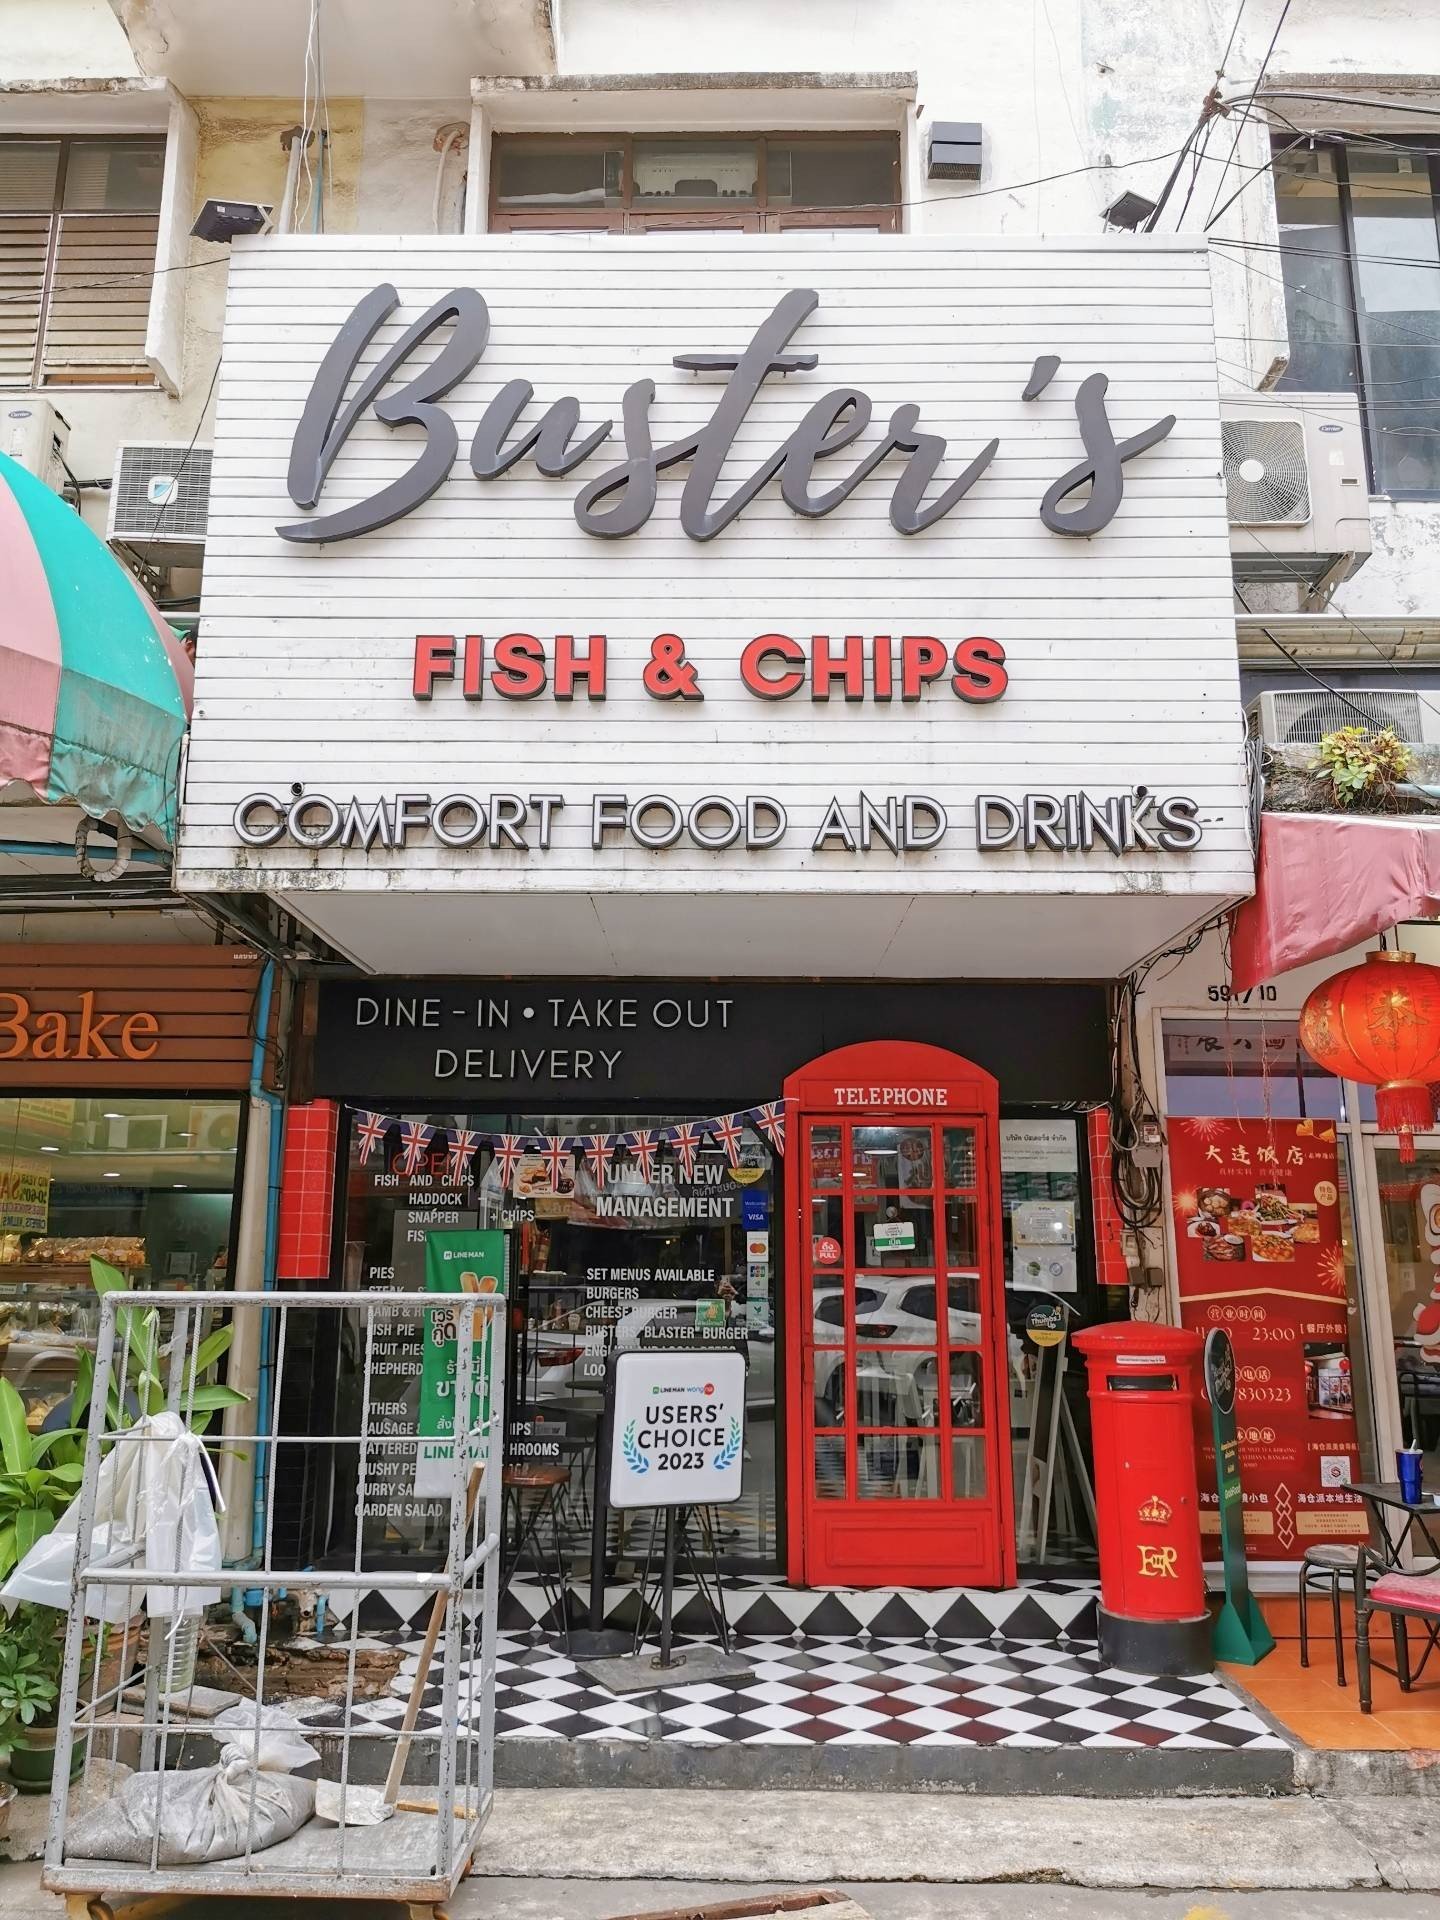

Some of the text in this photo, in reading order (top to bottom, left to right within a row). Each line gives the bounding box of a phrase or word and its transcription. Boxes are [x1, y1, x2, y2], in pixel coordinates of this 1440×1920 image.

[276, 283, 1176, 545] Buster's
[412, 634, 1010, 703] FISH & CHIPS
[233, 790, 1205, 856] COMFORT FOOD AND DRINKS
[548, 999, 638, 1028] TAKE
[653, 999, 734, 1028] OUT
[0, 991, 160, 1060] Bake
[434, 1048, 624, 1079] DELIVERY
[834, 1087, 948, 1106] TELEPHONE
[374, 1174, 399, 1187] FISH
[409, 1174, 433, 1187] AND
[607, 1164, 724, 1185] UNER NEW
[409, 1193, 463, 1206] HADDOCK
[596, 1197, 735, 1218] MANAGEMENT
[408, 1211, 459, 1224] SNAPPER
[502, 1210, 535, 1222] CHIPS
[407, 1230, 428, 1242] FIS
[369, 1266, 395, 1279] PIES
[587, 1268, 715, 1282] SET MENUS AVAILABLE
[586, 1287, 639, 1299] BURGERS
[369, 1305, 400, 1317] AMB
[586, 1305, 678, 1319] CHEESE BURGER
[368, 1323, 416, 1336] ISH PIE
[585, 1325, 637, 1338] BUSTERS
[702, 1327, 749, 1340] BURGER
[1252, 1327, 1295, 1341] 23:00
[365, 1342, 425, 1356] RUIT PIES
[363, 1402, 408, 1415] THERS
[646, 1403, 724, 1425] USERS'
[360, 1421, 414, 1435] AUSAGE
[638, 1428, 725, 1449] CHOICE
[359, 1442, 417, 1456] ATTERED
[424, 1445, 454, 1459] LINE
[658, 1452, 705, 1471] 2023
[405, 1504, 443, 1517] SALAD
